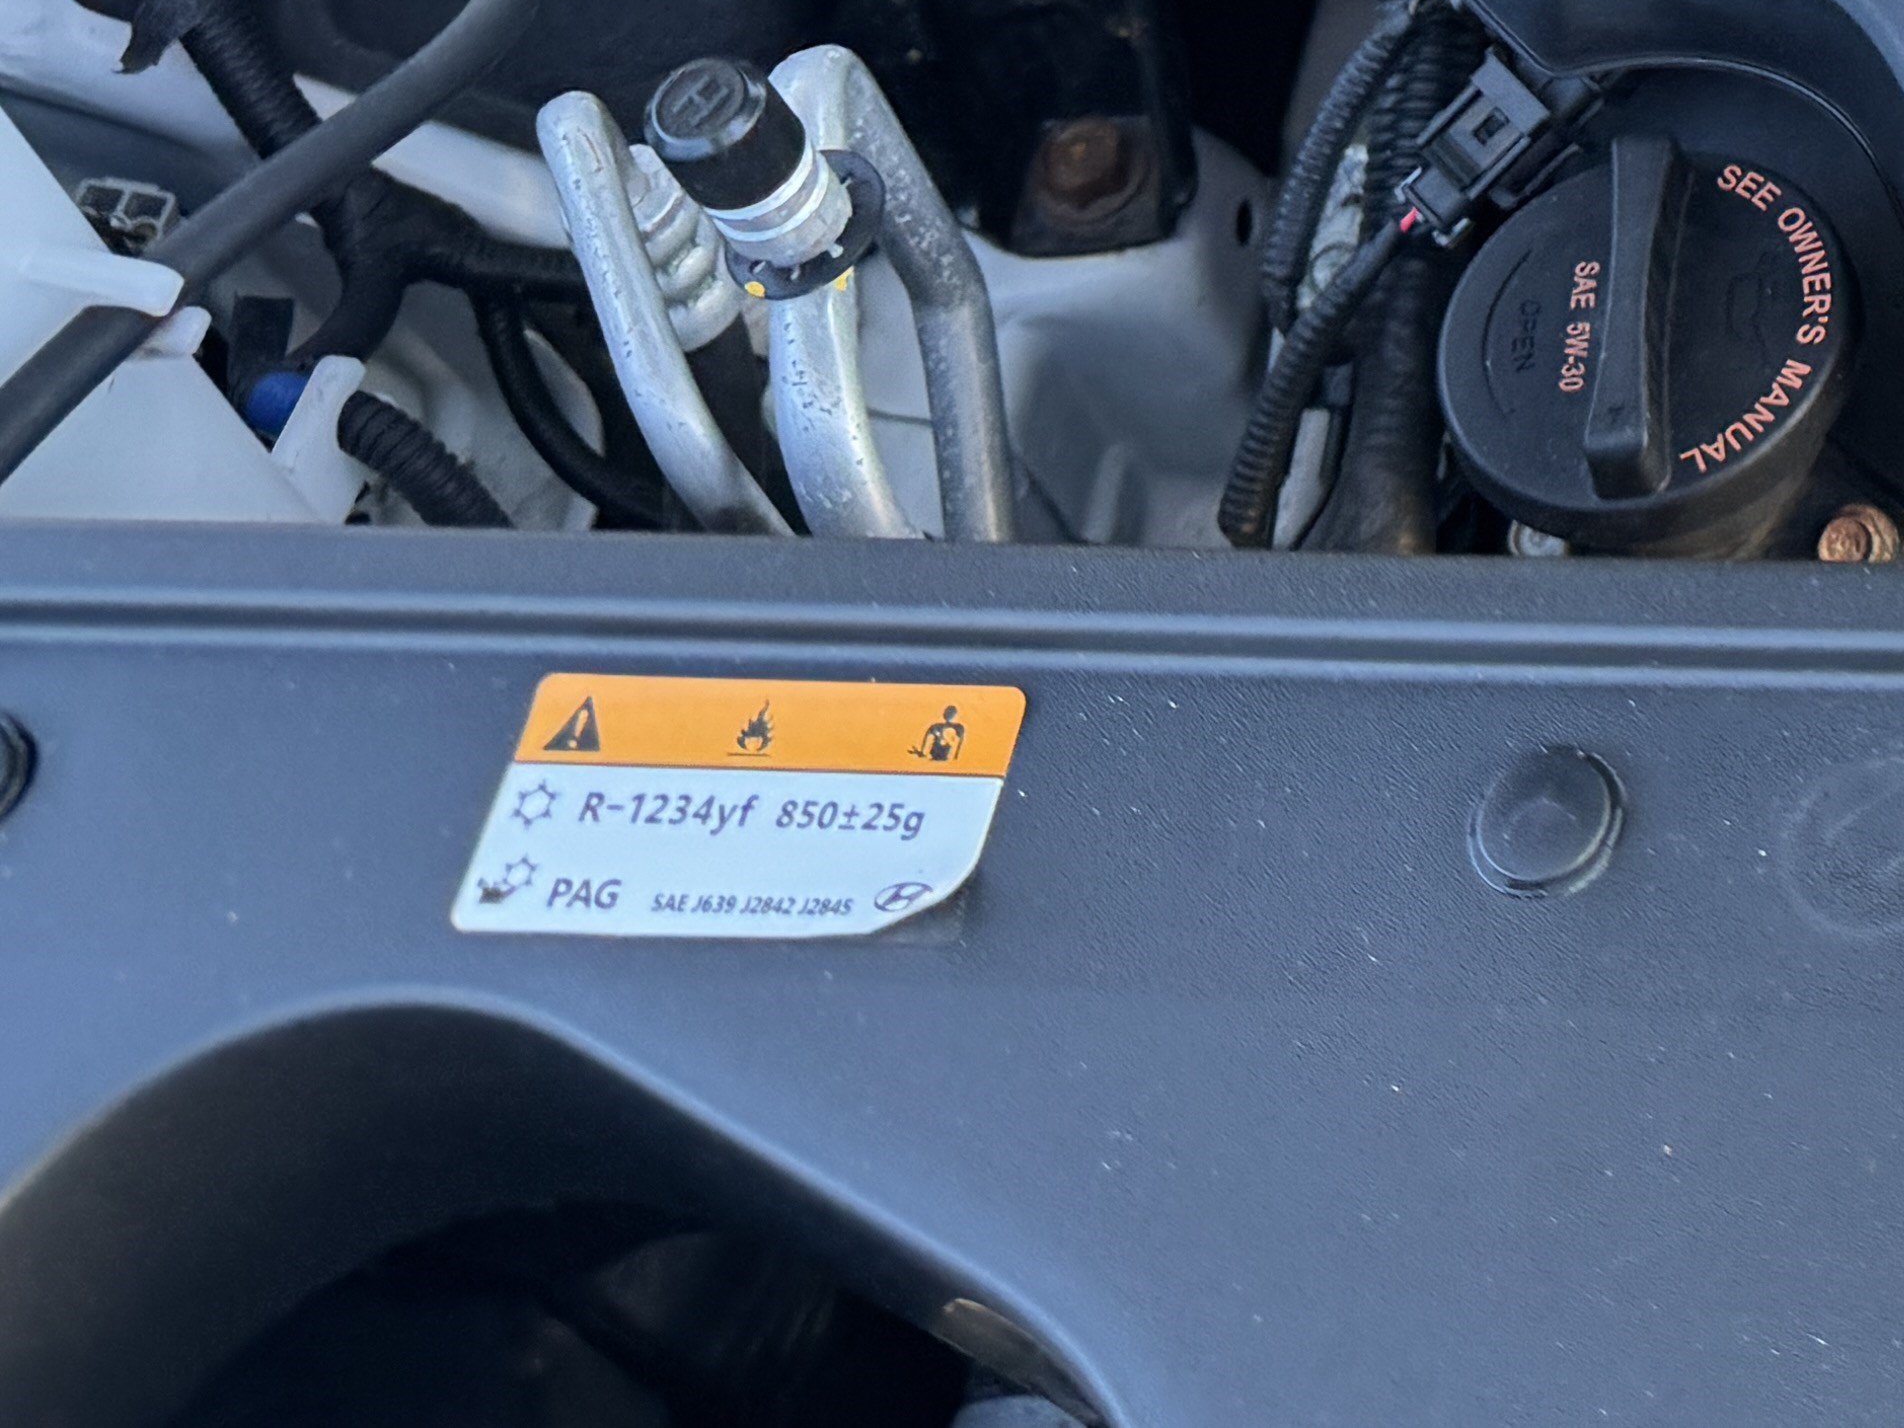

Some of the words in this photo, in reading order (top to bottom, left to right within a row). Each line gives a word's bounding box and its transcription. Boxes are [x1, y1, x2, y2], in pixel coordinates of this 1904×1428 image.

[1716, 164, 1782, 212] SEE
[1569, 260, 1601, 311] SAE
[1777, 206, 1833, 346] OWNER'S
[1557, 321, 1591, 393] 5W-30
[1679, 358, 1812, 473] MANUAL
[577, 790, 760, 836] R-1234yf
[775, 799, 926, 841] 850±25g
[546, 877, 623, 910] PAG
[650, 893, 689, 913] SAE
[689, 894, 737, 915] J639
[739, 896, 798, 916] J2842
